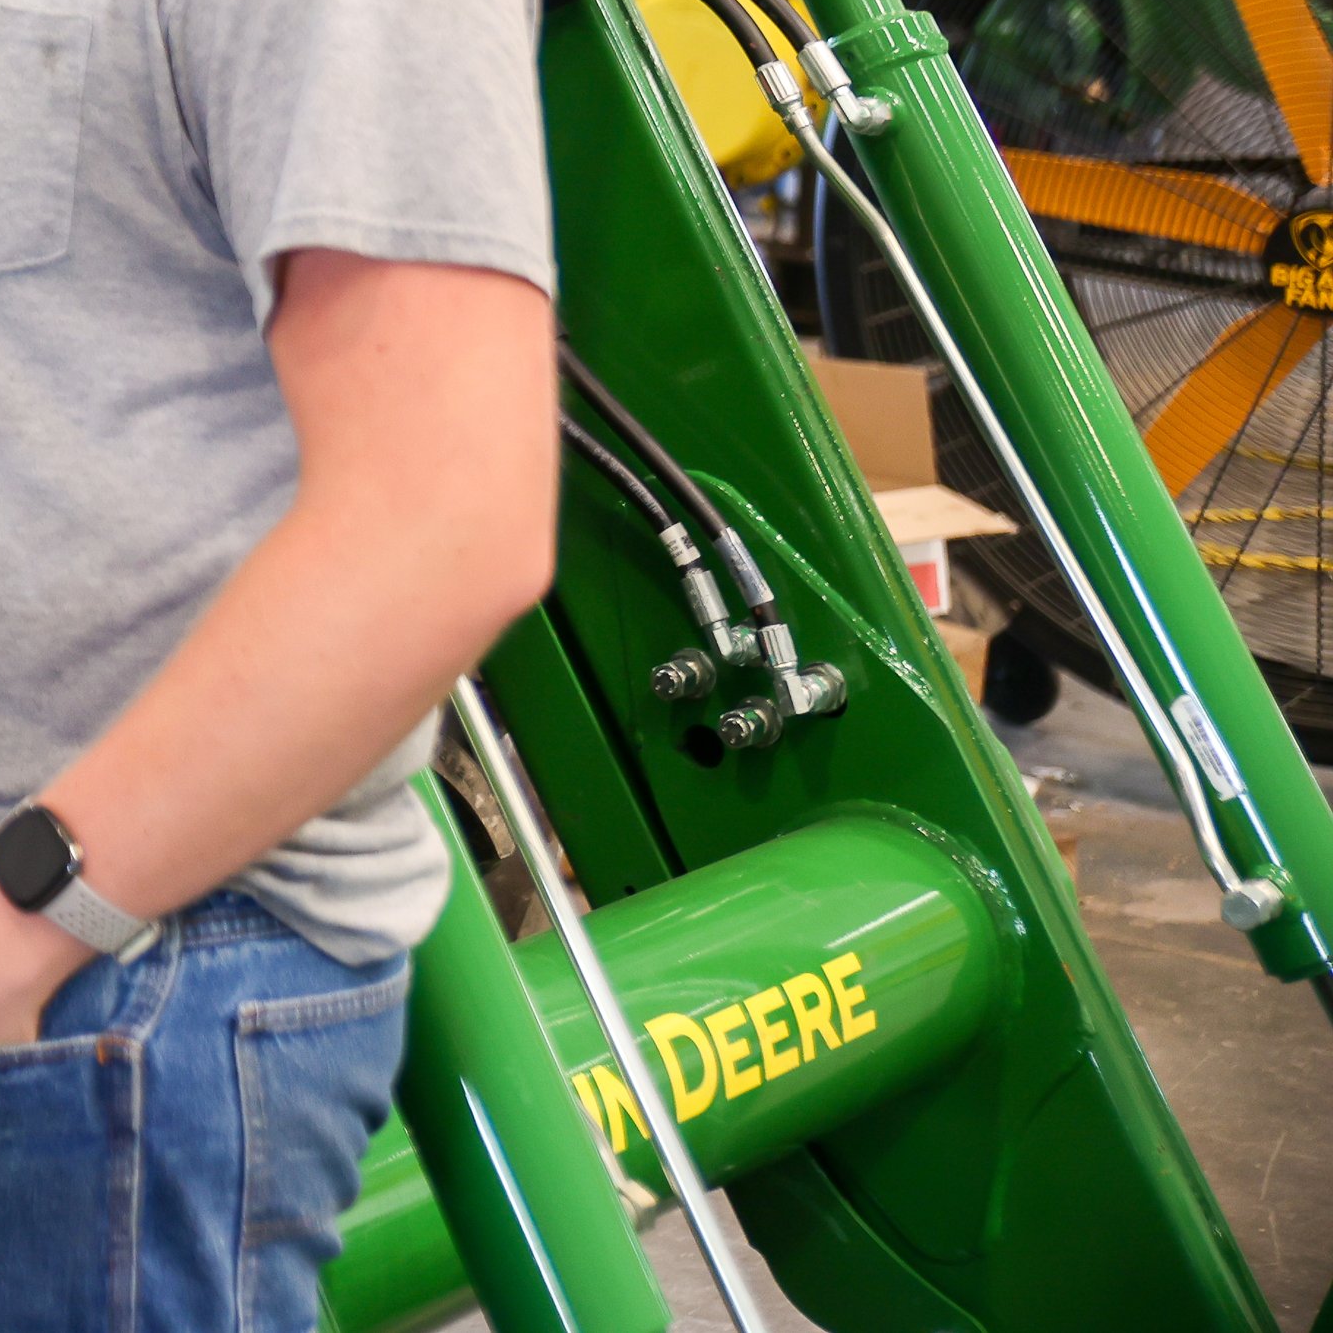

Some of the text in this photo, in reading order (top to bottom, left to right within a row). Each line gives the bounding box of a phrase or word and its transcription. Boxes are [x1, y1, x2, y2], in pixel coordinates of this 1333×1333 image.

[1270, 262, 1315, 288] BIG
[1285, 286, 1333, 310] FAN
[643, 951, 877, 1124] DEERE
